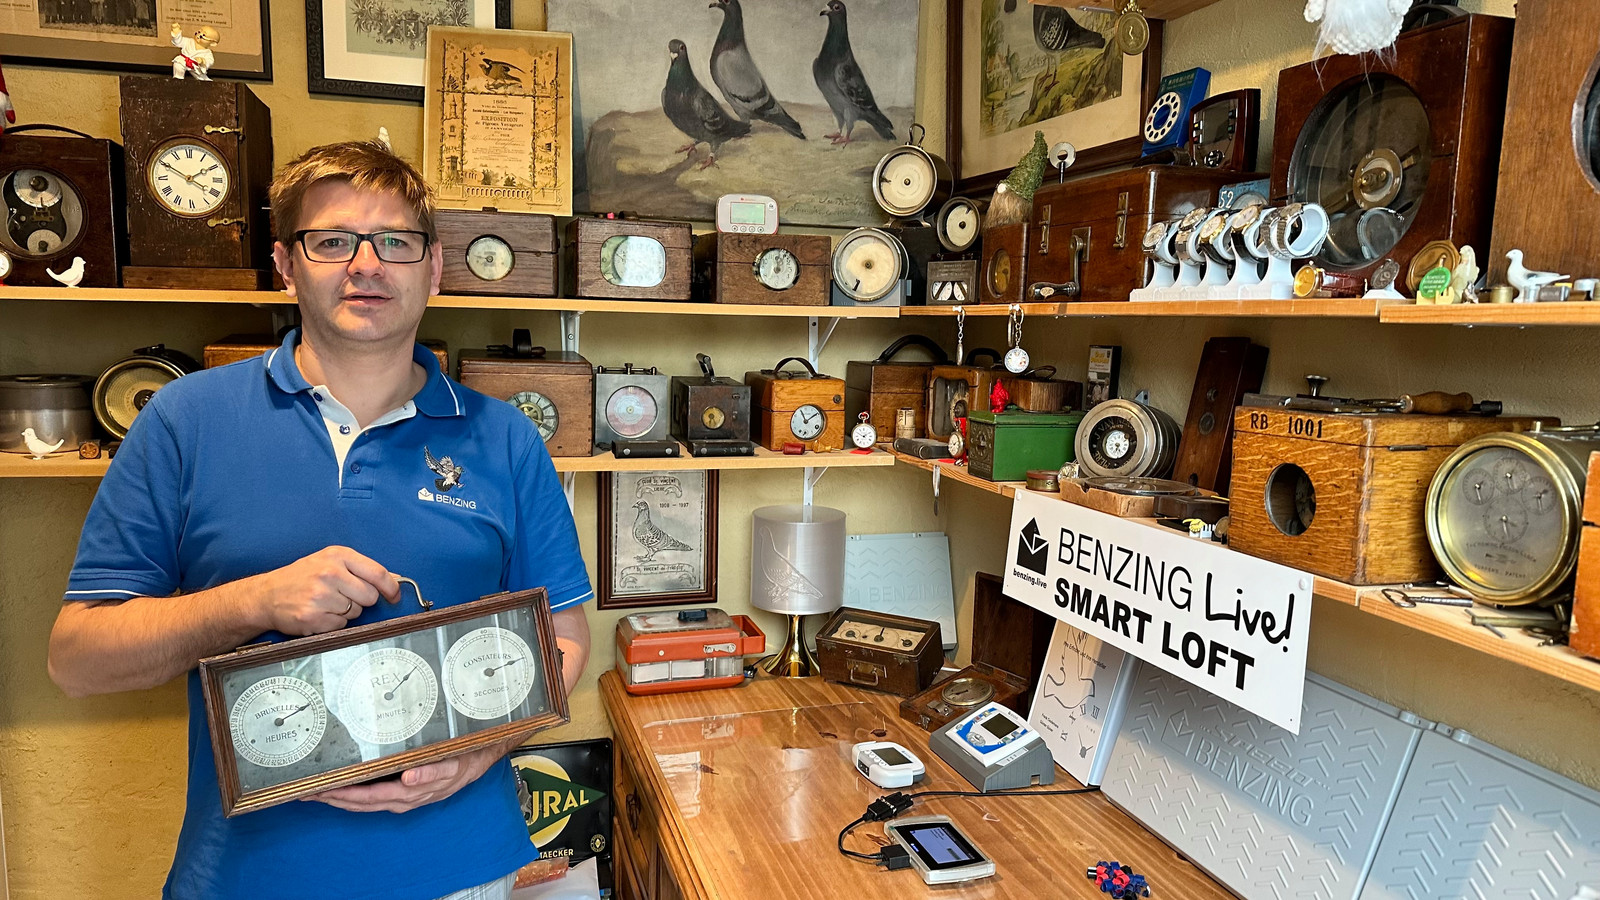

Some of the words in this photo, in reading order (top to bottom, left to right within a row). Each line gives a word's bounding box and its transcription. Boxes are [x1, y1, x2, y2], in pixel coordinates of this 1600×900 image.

[1218, 190, 1234, 208] 52
[1250, 413, 1268, 430] RB
[1288, 416, 1322, 438] 1001
[436, 494, 476, 510] BENZING
[1013, 568, 1047, 588] benzing.live
[869, 584, 948, 602] BENZING
[1058, 527, 1192, 612] BENZING
[1205, 572, 1295, 652] Live!
[1054, 577, 1152, 644] SMART
[1162, 621, 1254, 690] LOFT
[464, 653, 512, 668] CONSTATEURS
[370, 672, 401, 688] REX
[474, 686, 509, 698] SECONDES
[254, 704, 300, 720] BRUXELLES
[376, 708, 406, 720] MINUTES
[265, 730, 298, 743] HEURES
[1194, 737, 1314, 826] BENZING
